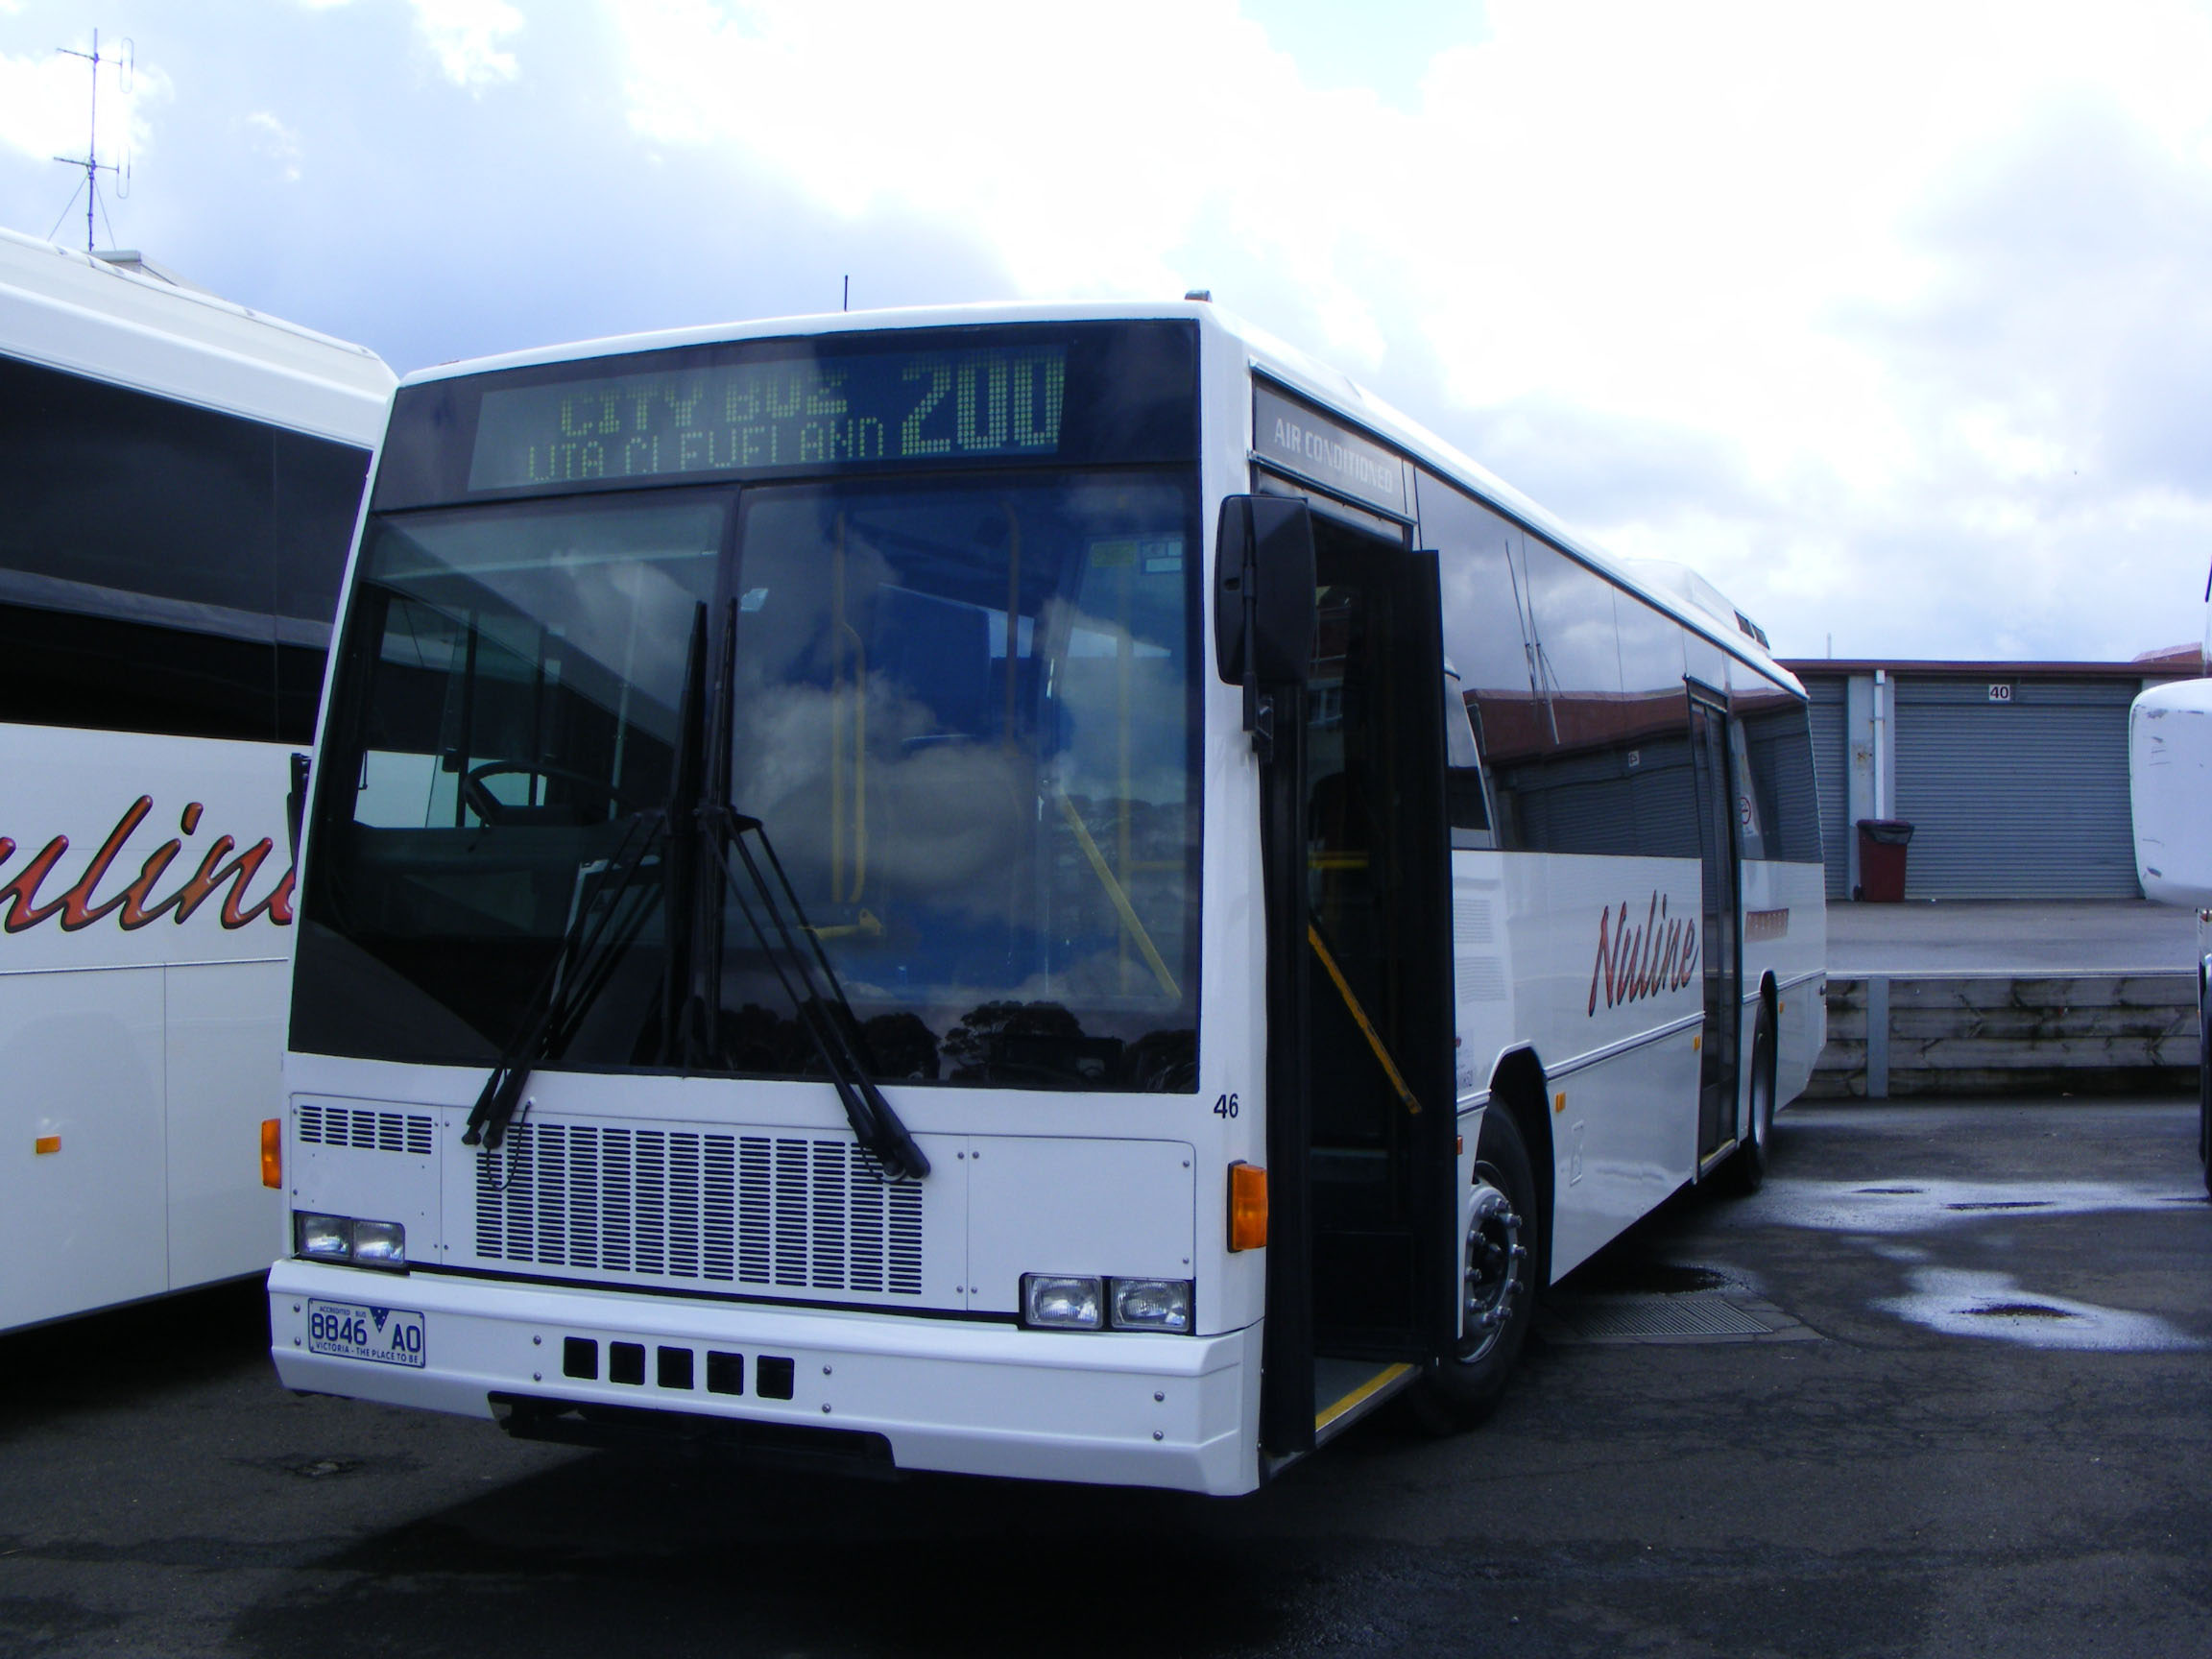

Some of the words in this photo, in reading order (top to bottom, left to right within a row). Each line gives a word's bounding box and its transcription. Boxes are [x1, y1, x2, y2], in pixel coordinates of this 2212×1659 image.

[560, 383, 704, 436] CITY
[901, 354, 1065, 459] 200
[1275, 419, 1302, 453] AIR
[1304, 431, 1393, 493] CONDITIONED
[1990, 686, 2008, 698] 40
[1588, 889, 1699, 1018] Nuline
[1213, 1093, 1238, 1119] 46
[311, 1312, 368, 1346] 8846
[316, 1342, 349, 1353] VICTORIA
[355, 1347, 370, 1357] THE
[372, 1350, 395, 1360] PLACE
[408, 1355, 419, 1363] BE
